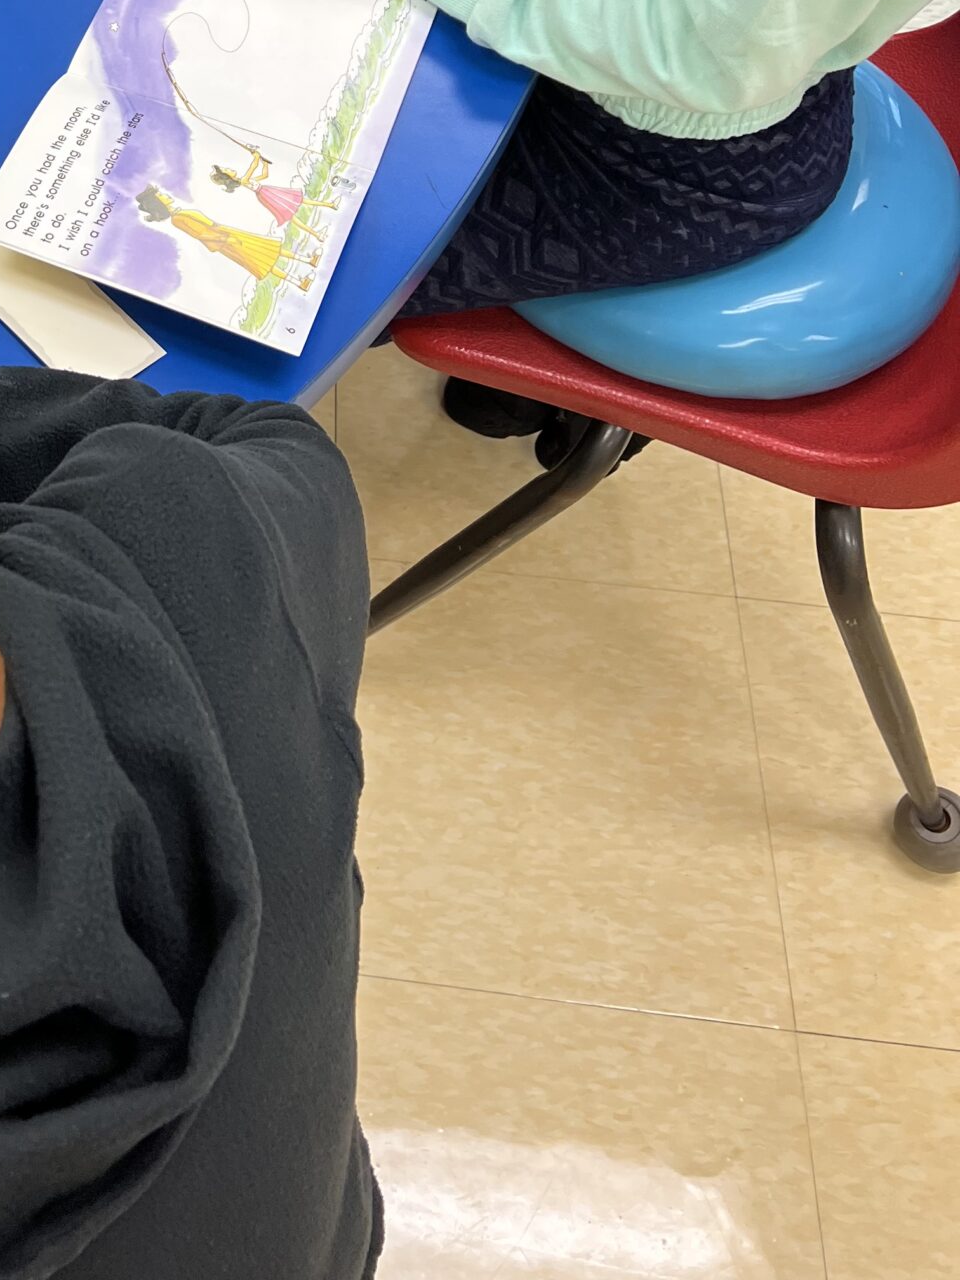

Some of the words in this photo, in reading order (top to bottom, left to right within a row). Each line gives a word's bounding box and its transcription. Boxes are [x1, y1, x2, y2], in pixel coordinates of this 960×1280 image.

[4, 201, 29, 230] Once
[25, 177, 43, 200] you
[37, 153, 57, 176] had
[50, 133, 67, 151] the
[63, 105, 88, 132] moon,
[22, 203, 50, 237] there's
[45, 149, 82, 200] something
[76, 127, 92, 147] else
[85, 113, 101, 127] I'd
[94, 99, 111, 113] like
[40, 232, 55, 244] to
[51, 212, 68, 229] do.
[58, 243, 71, 252] I
[66, 219, 84, 242] wish
[77, 209, 89, 217] I
[84, 178, 105, 208] could
[102, 148, 122, 176] catch
[117, 130, 132, 146] the
[128, 112, 145, 129] stars
[80, 243, 94, 257] on
[89, 230, 100, 239] a
